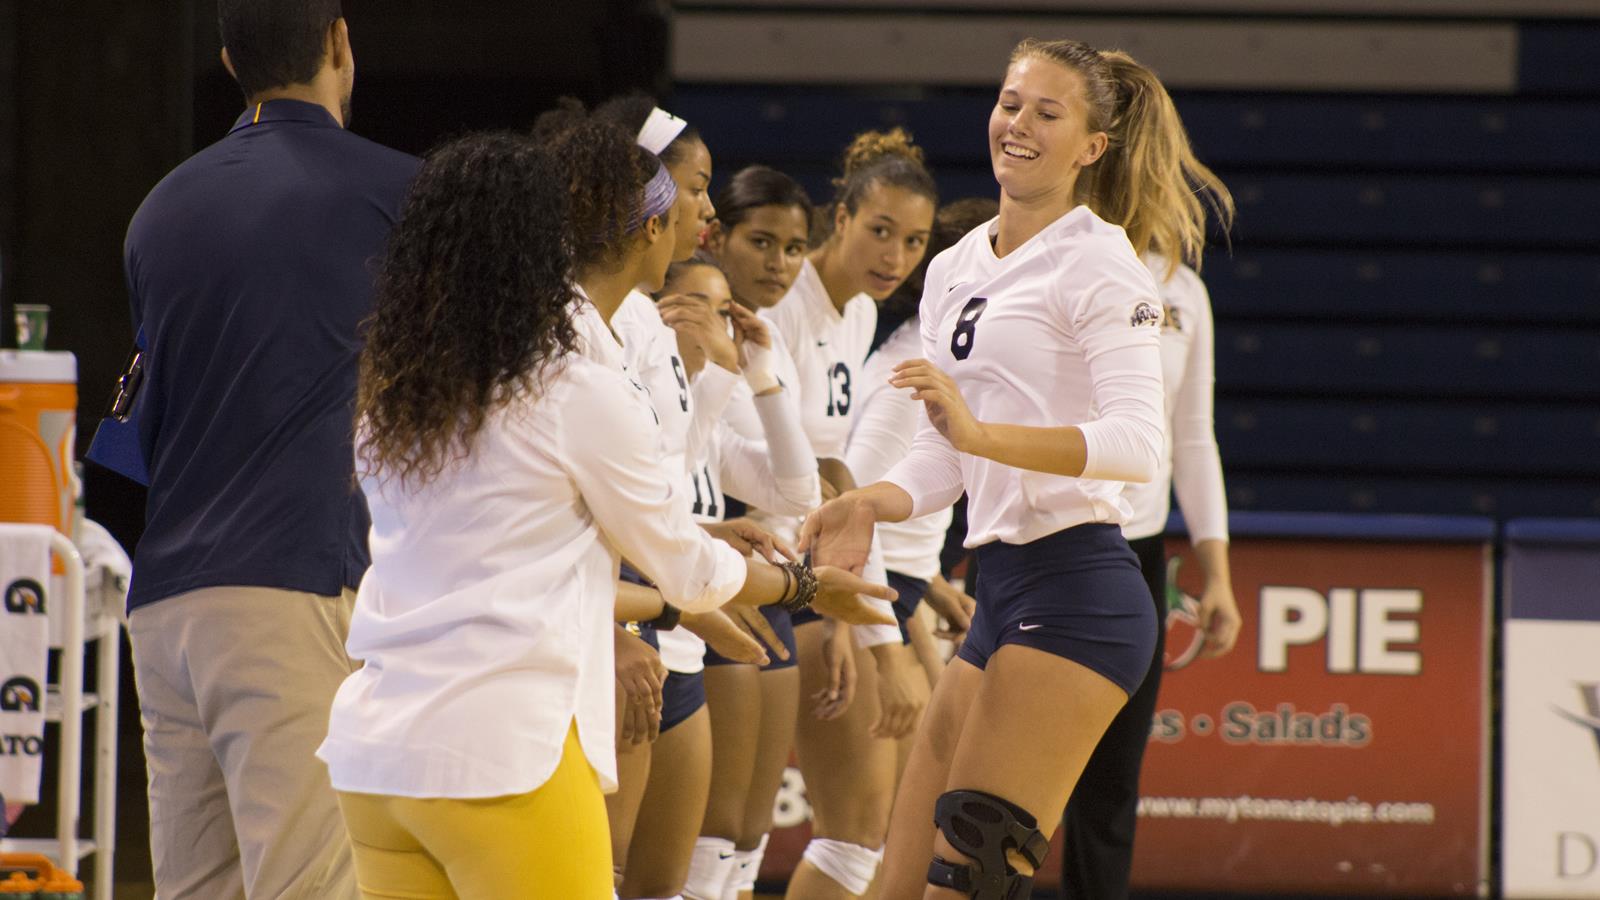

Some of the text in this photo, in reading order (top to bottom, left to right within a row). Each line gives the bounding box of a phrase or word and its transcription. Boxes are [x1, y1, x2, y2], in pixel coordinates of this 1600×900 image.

[950, 297, 988, 361] 8
[671, 355, 689, 413] 9
[826, 361, 851, 417] 13
[690, 464, 718, 517] 11
[1257, 585, 1423, 676] PIE
[0, 735, 44, 756] TO
[1220, 701, 1373, 748] Salads
[1136, 795, 1435, 825] www.mytomatopie.com
